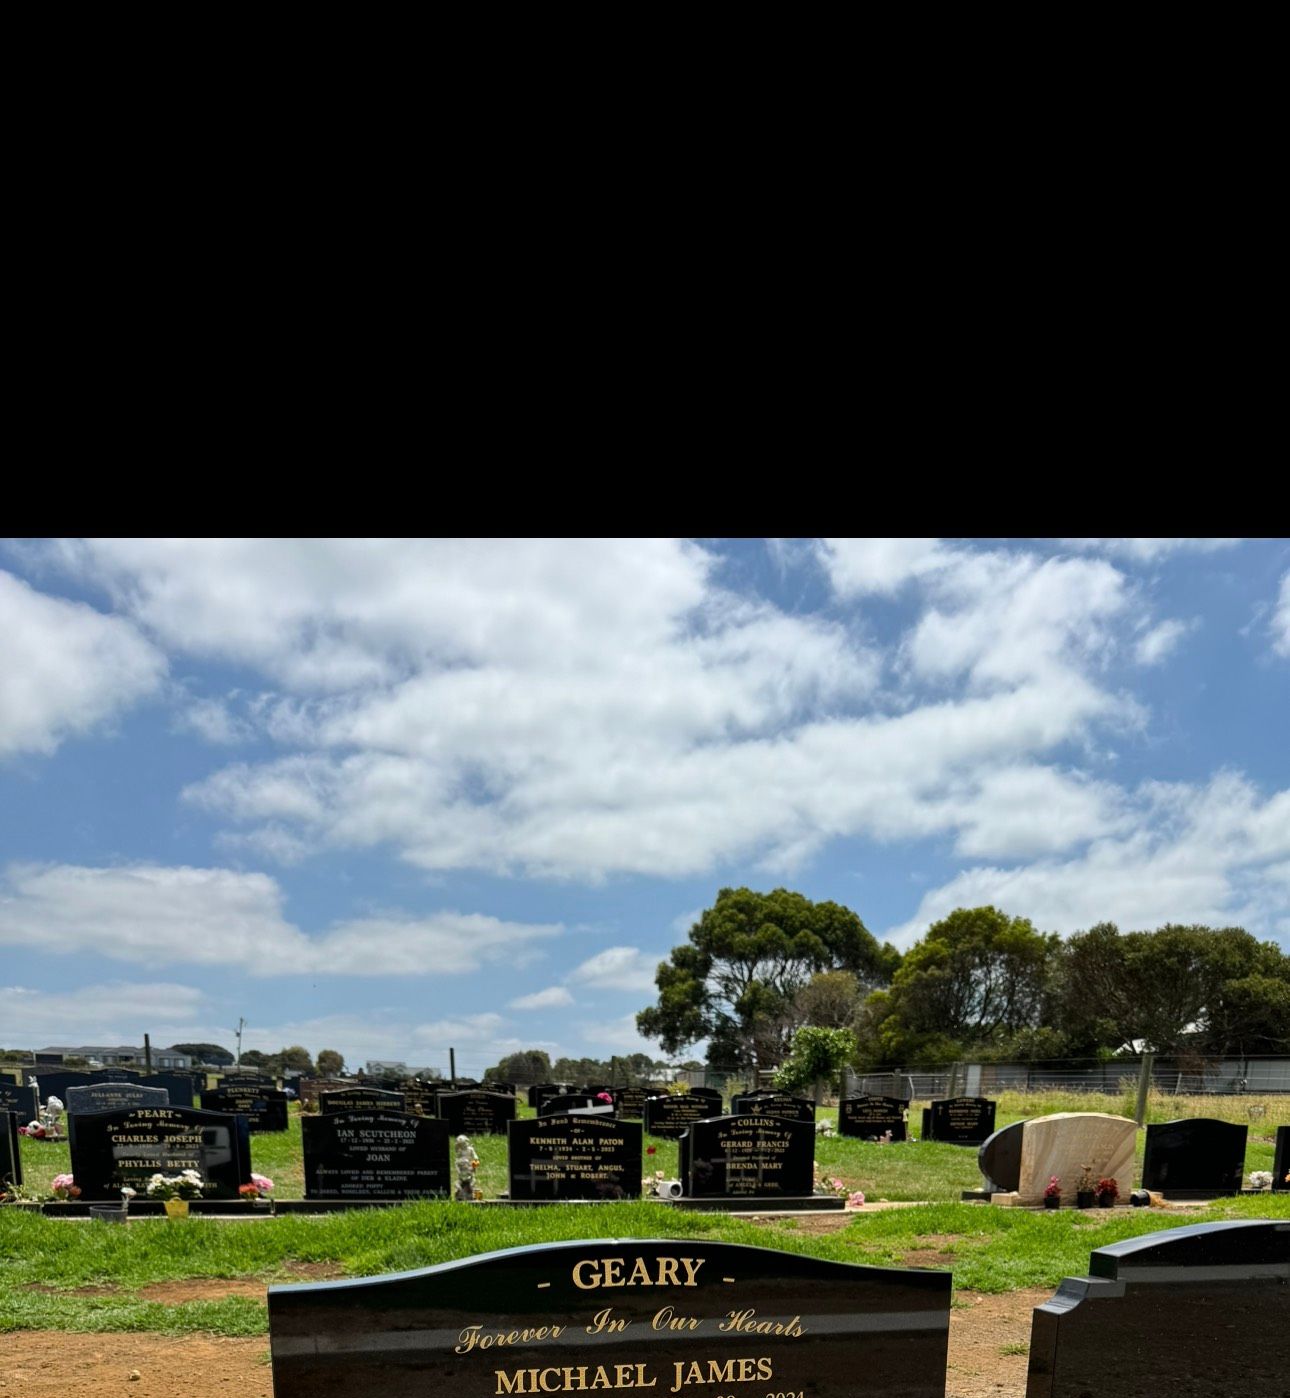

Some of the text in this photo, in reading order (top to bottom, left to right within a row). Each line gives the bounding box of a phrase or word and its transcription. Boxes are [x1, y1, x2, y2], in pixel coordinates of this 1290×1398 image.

[137, 1109, 174, 1119] PEART
[737, 1119, 774, 1127] COLLINS
[337, 1129, 417, 1139] IAN SCUTCHEON
[111, 1135, 203, 1143] CHARLES JOSEPH
[529, 1137, 567, 1145] KENNETH
[599, 1138, 624, 1146] PATON
[366, 1154, 391, 1162] JOAN
[118, 1160, 200, 1168] PHYLLIS BETTY
[598, 1164, 624, 1172] ANGUS,
[726, 1162, 783, 1170] BRENDA MARY
[546, 1172, 566, 1180] JOHN
[572, 1257, 706, 1290] GEARY
[453, 1306, 807, 1354] Forever In Our Hearts
[494, 1357, 773, 1395] MICHAEL JAMES
